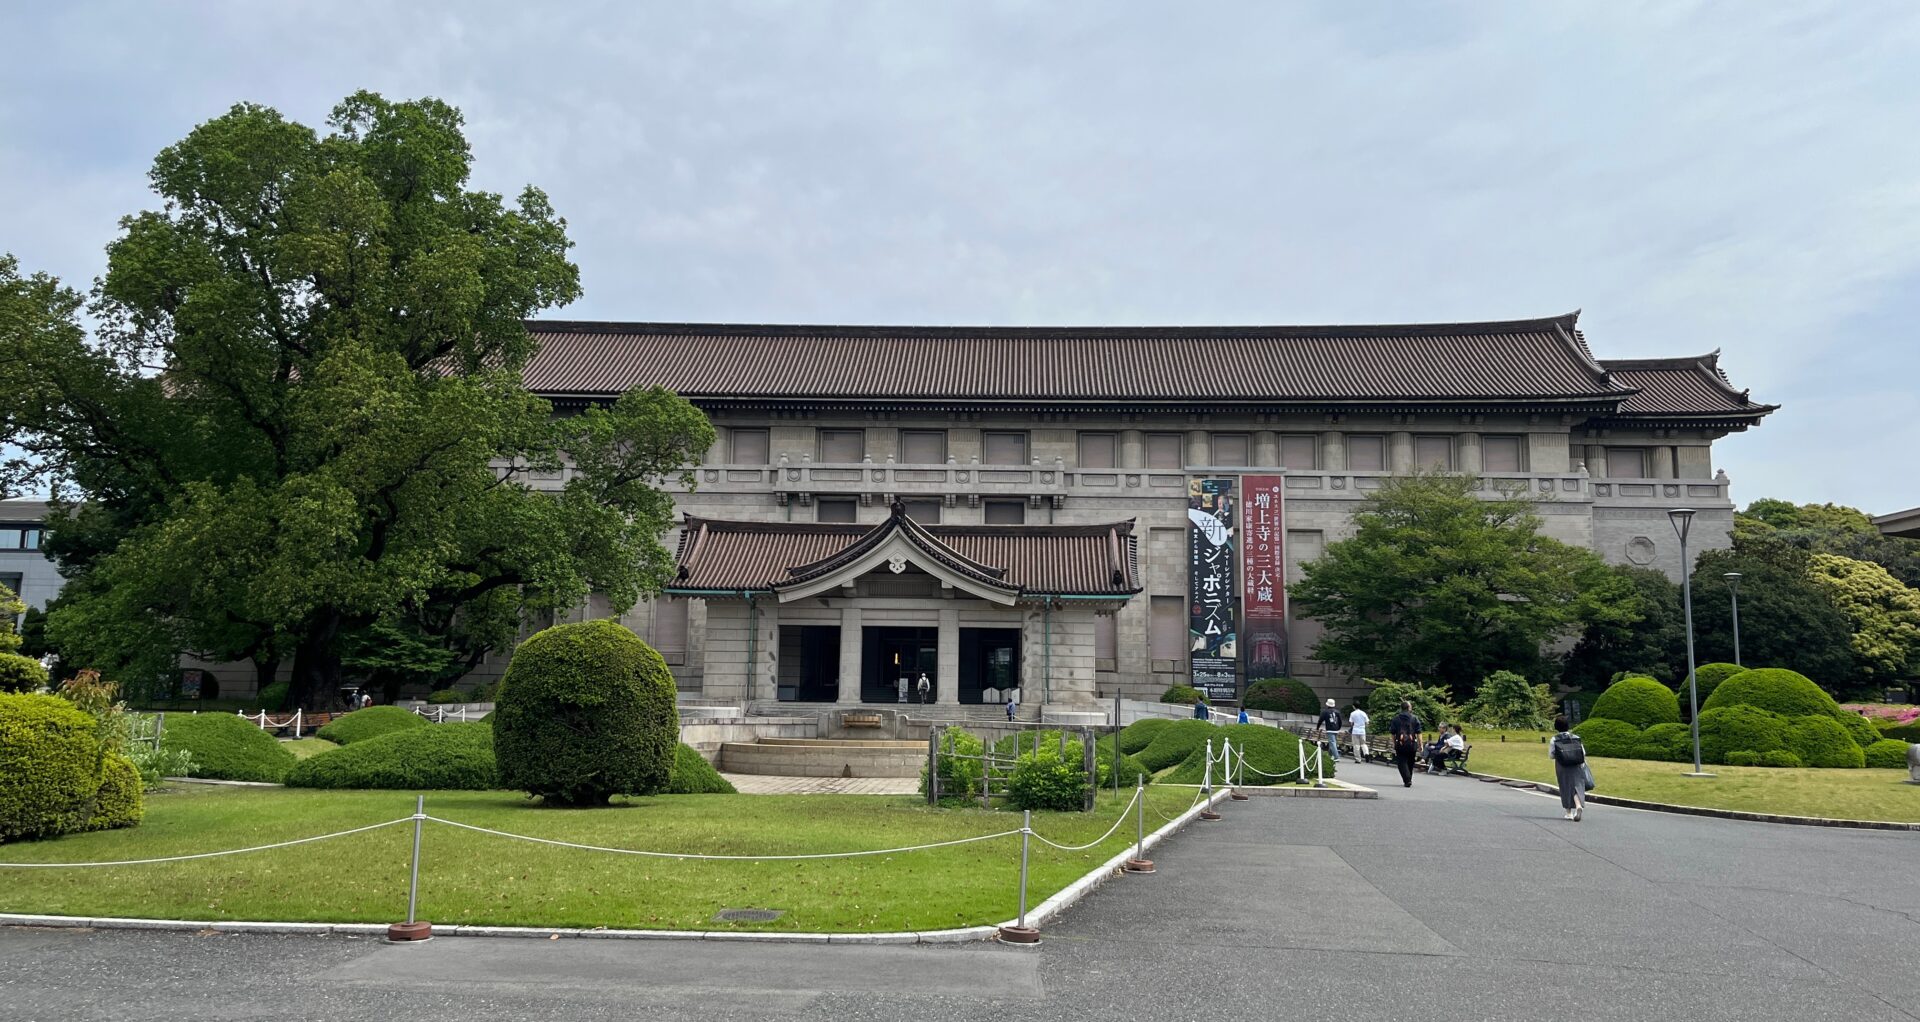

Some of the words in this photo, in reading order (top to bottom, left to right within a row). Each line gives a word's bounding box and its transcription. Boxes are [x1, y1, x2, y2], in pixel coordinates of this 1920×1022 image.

[1199, 516, 1224, 636] 新ジャポニズム
[1254, 493, 1273, 603] 増上寺の三大蔵
